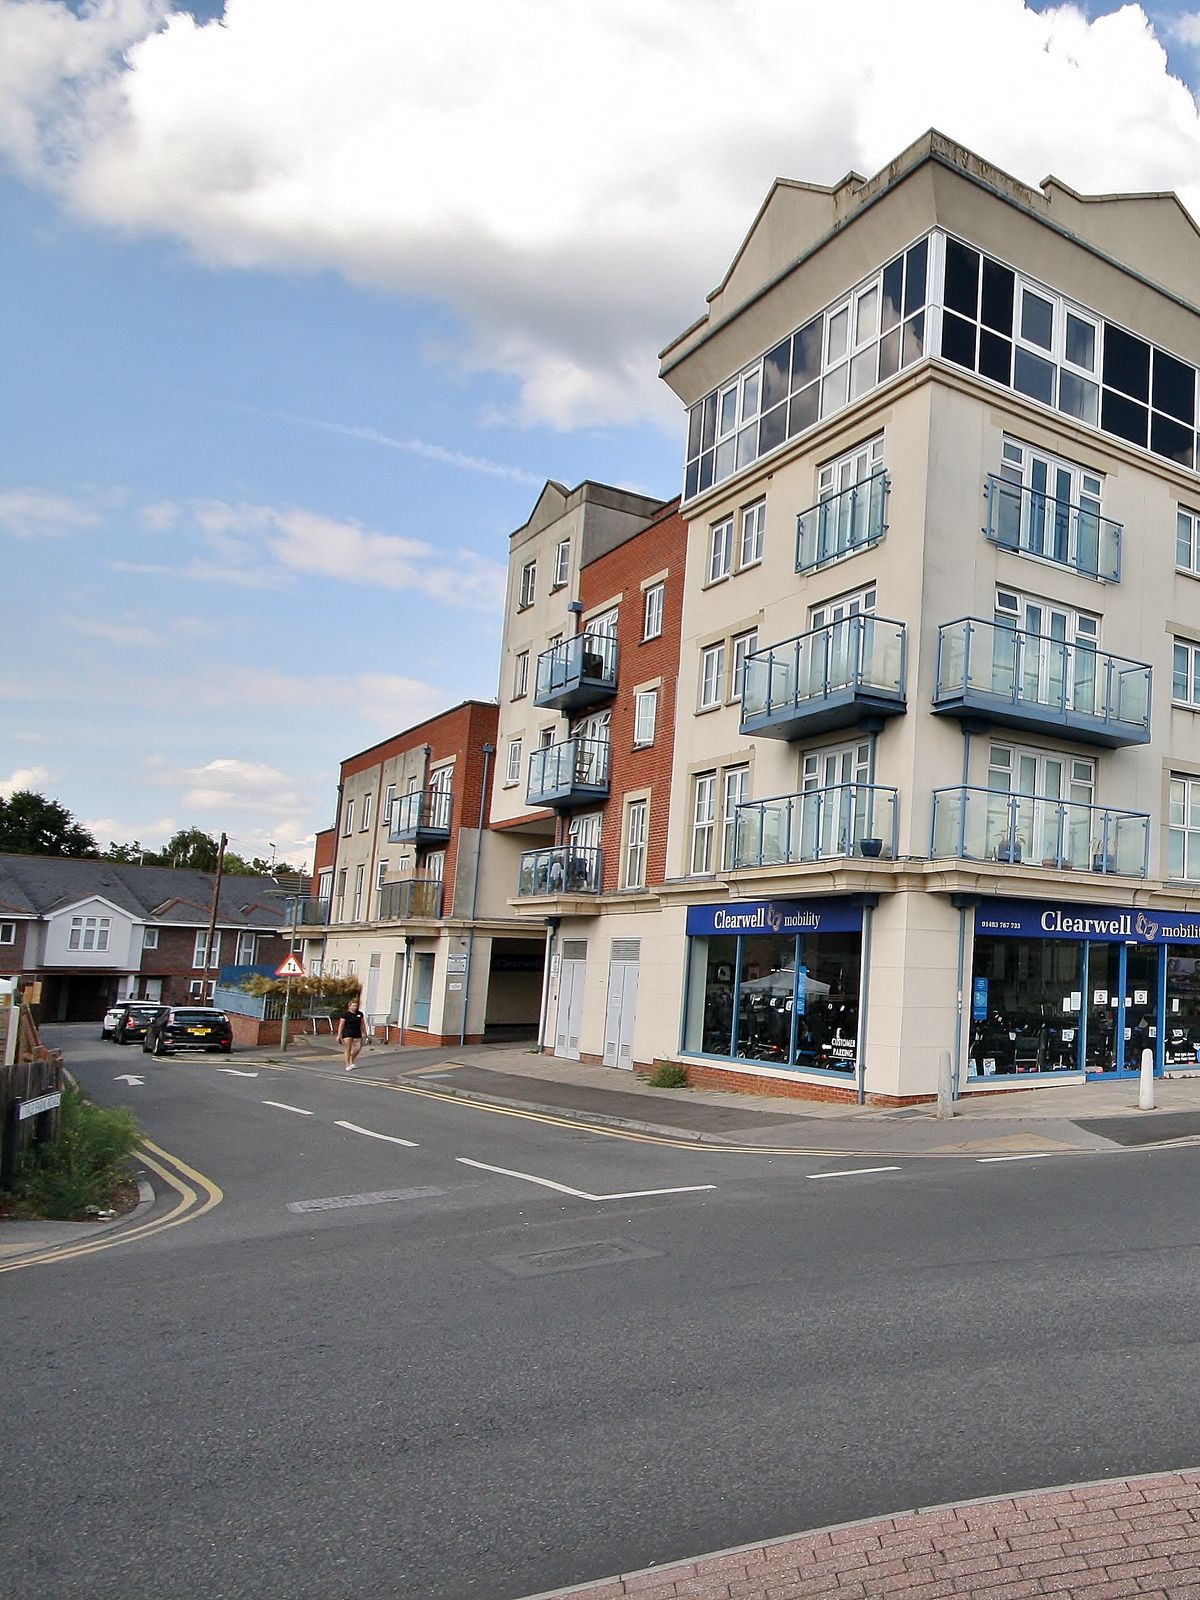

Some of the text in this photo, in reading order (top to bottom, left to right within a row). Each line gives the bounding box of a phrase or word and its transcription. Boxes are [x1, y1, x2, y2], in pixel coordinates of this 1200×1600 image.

[714, 908, 821, 929] Clearwell mobility
[1041, 911, 1132, 935] Clearwell
[831, 1038, 856, 1047] CUSTOMER
[832, 1048, 854, 1057] PARKING
